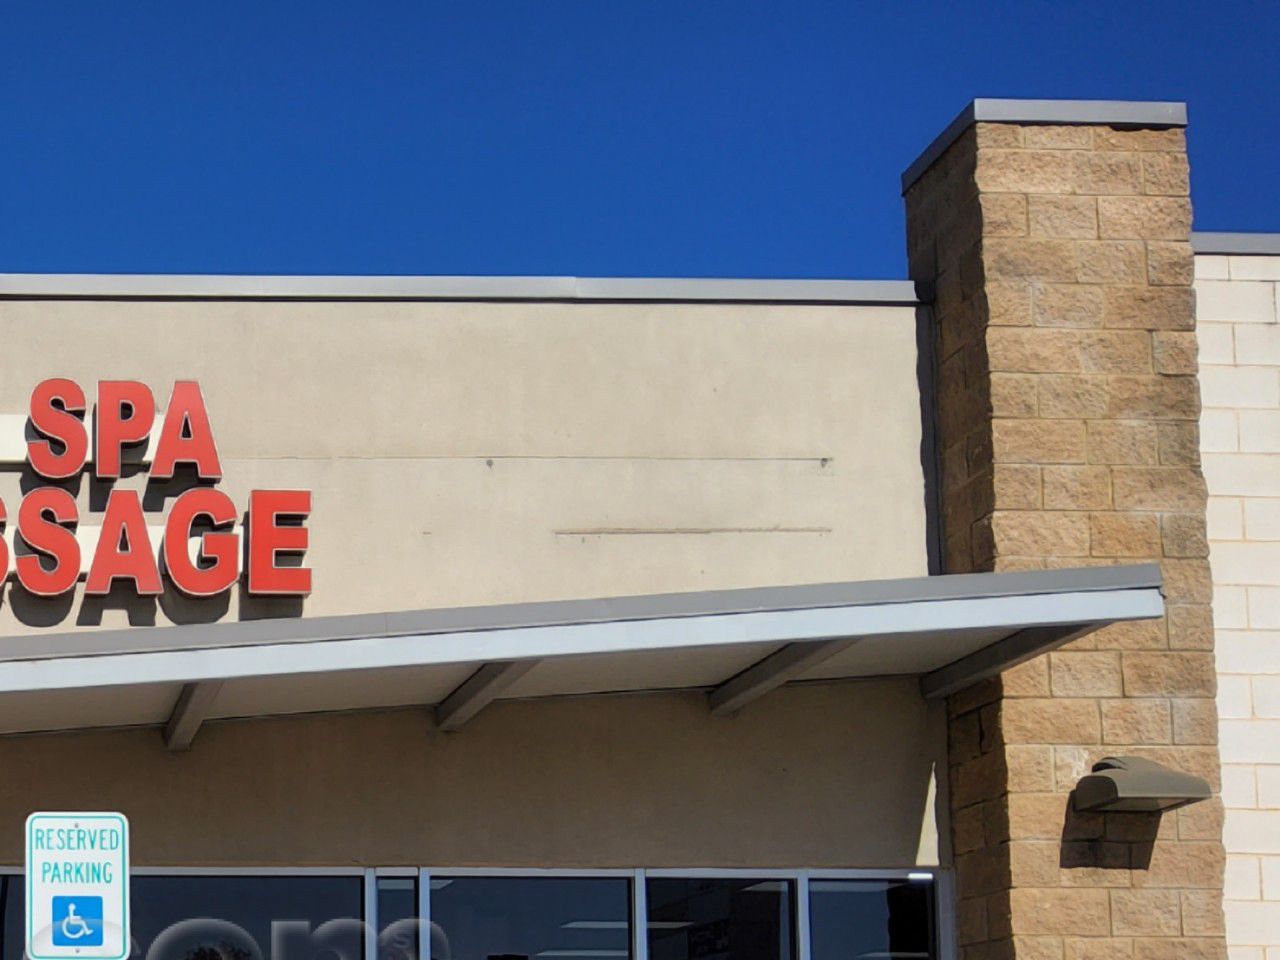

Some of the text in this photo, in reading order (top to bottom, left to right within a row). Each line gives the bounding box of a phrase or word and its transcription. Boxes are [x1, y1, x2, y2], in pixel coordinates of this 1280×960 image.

[27, 377, 222, 480] SPA
[35, 828, 119, 850] RESERVED
[41, 861, 113, 884] PARKING
